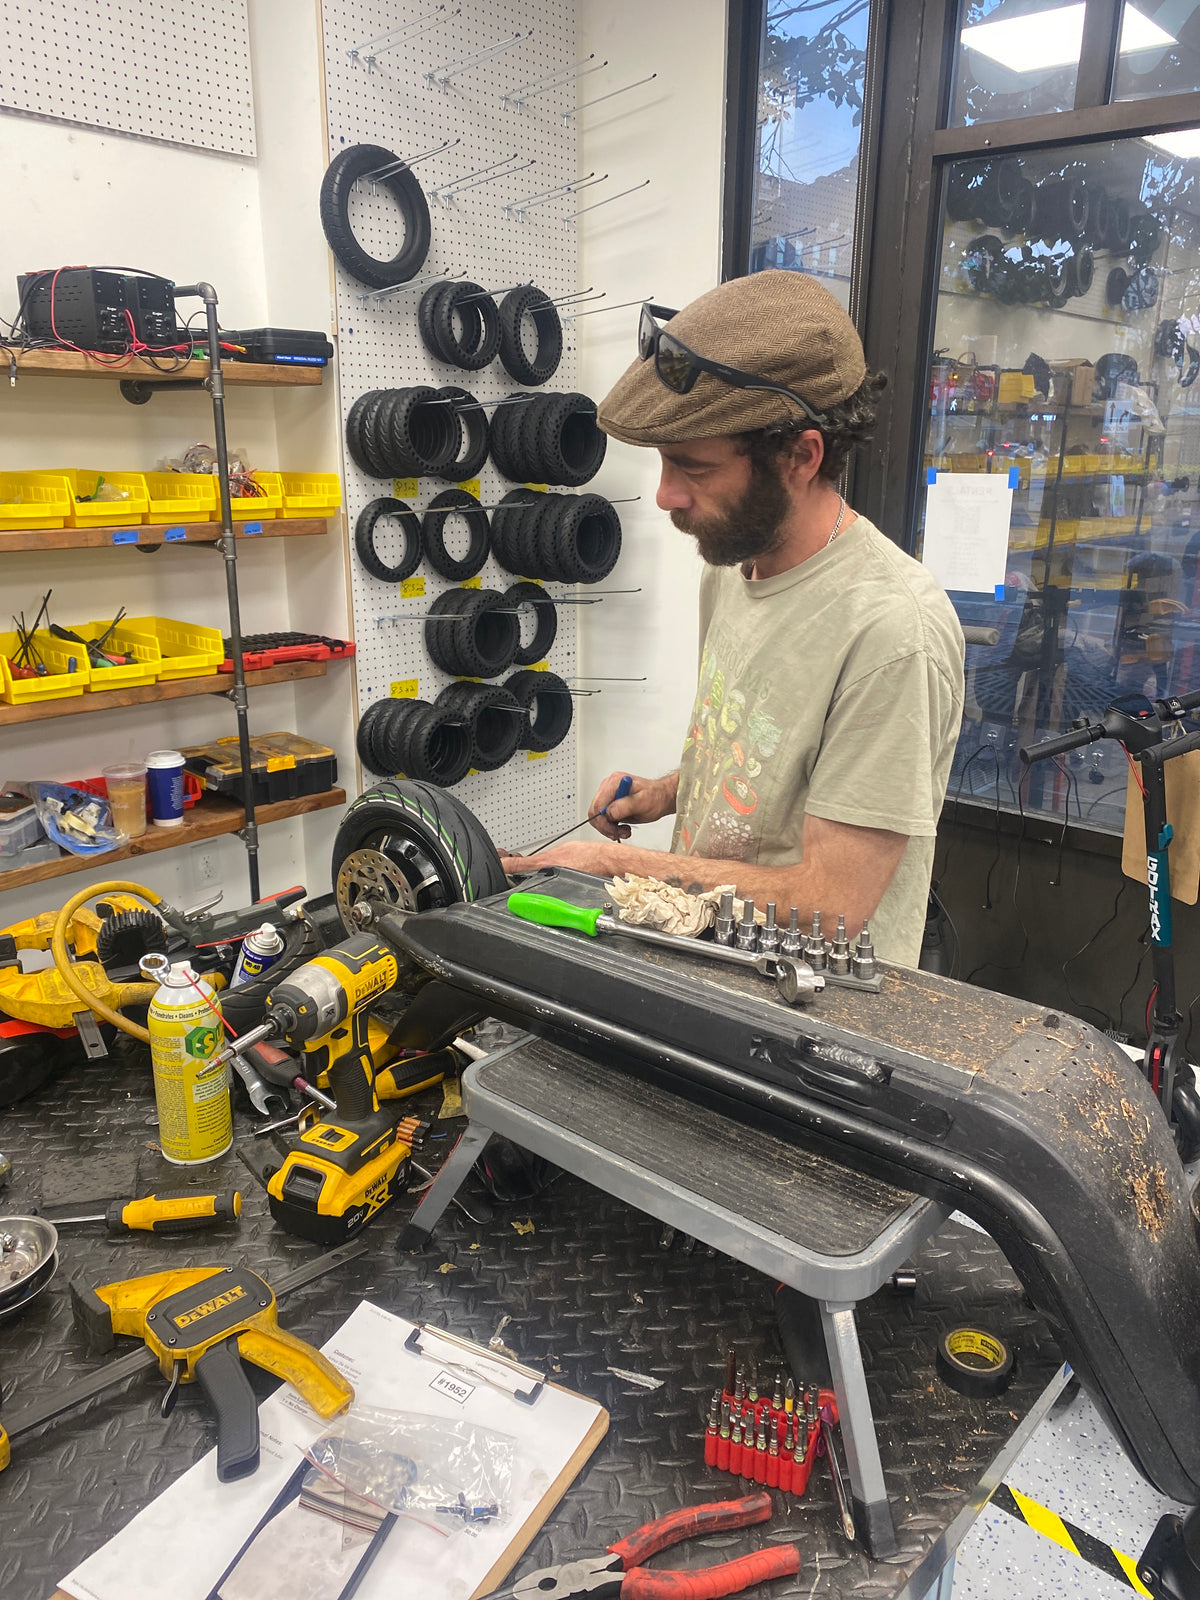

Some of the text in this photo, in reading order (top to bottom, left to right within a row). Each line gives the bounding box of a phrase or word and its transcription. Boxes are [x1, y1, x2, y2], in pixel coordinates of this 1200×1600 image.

[1147, 855, 1161, 941] GOTRAX
[173, 1285, 248, 1329] DEWALT
[436, 1377, 468, 1398] #1952
